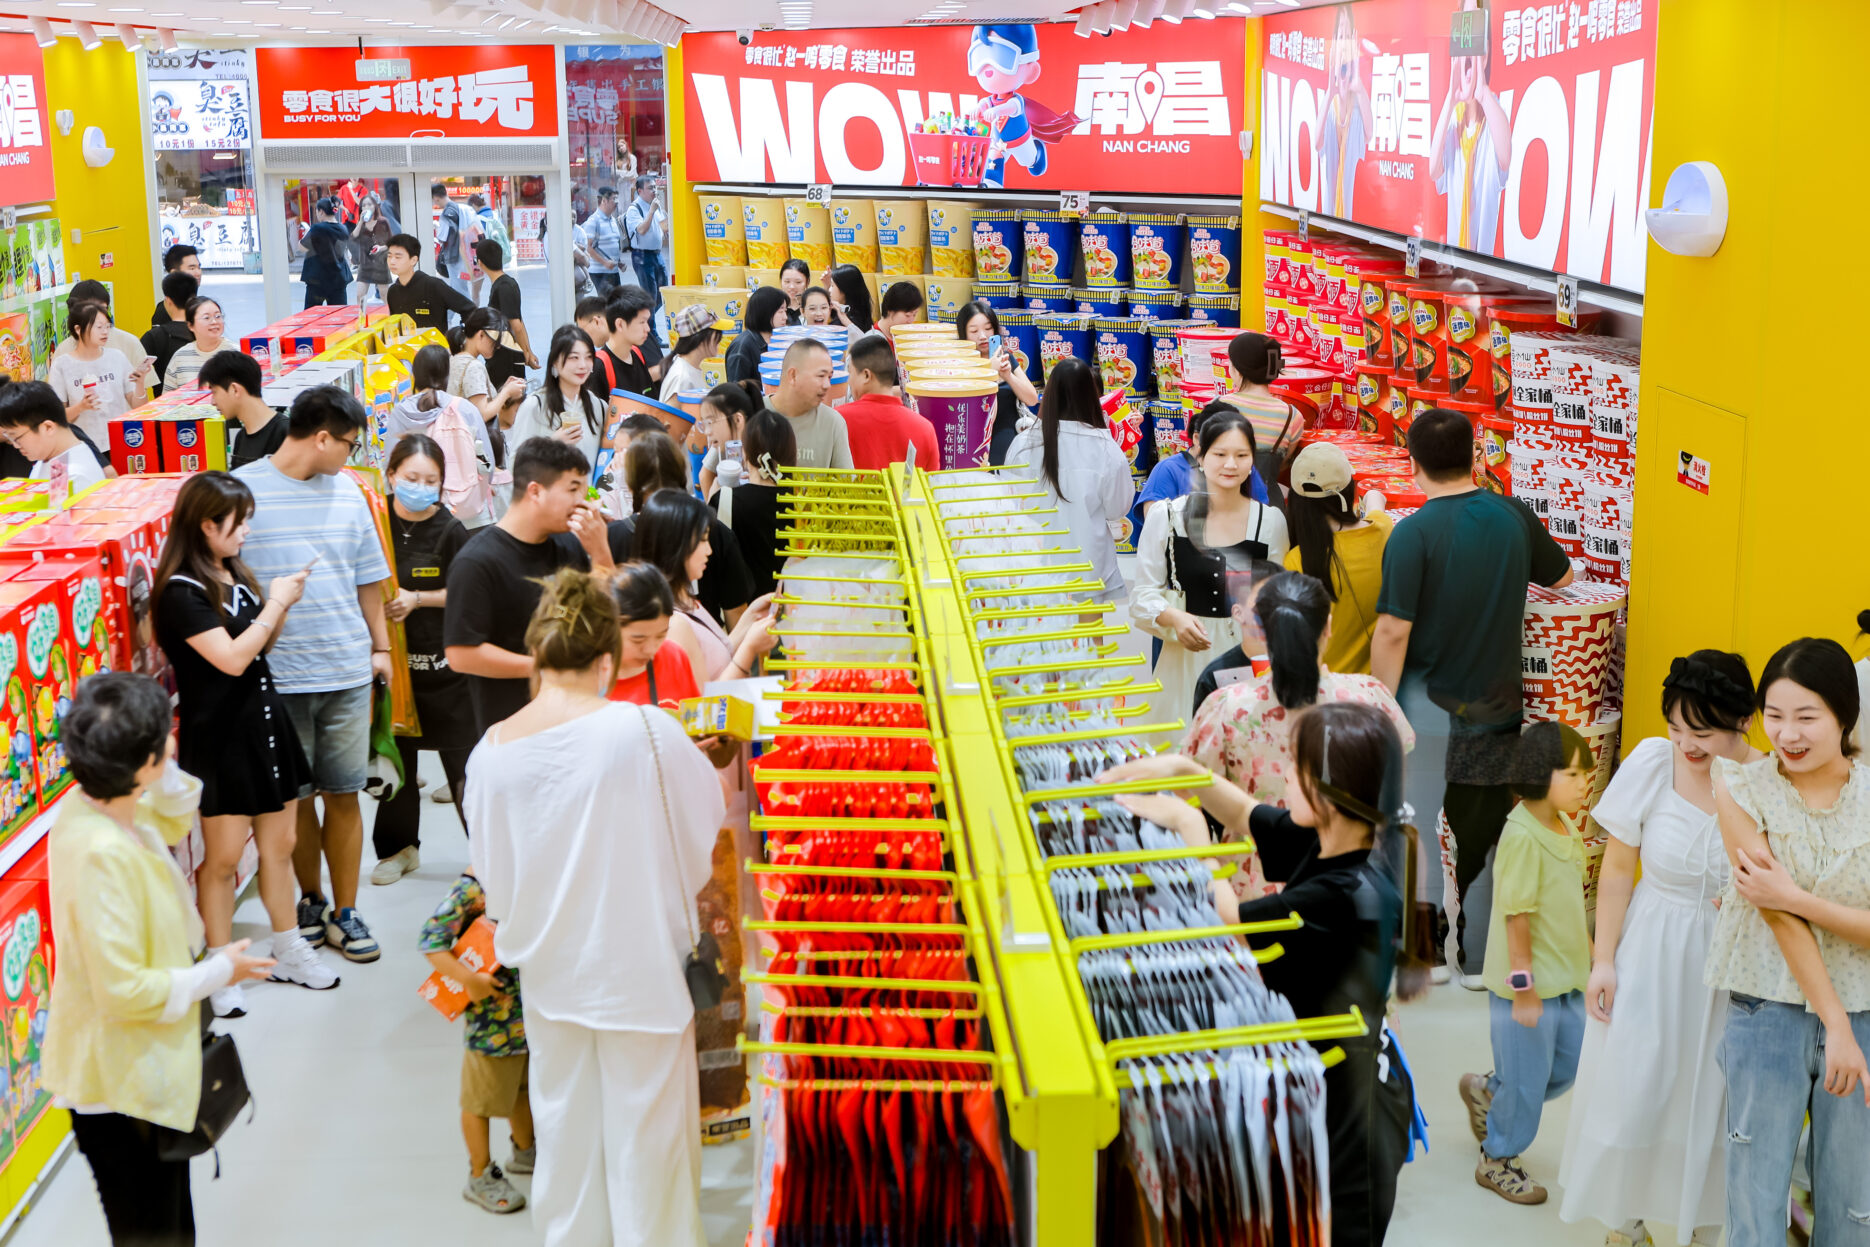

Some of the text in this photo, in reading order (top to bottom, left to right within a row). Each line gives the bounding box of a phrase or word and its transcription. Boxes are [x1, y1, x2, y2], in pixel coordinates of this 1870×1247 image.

[850, 49, 916, 77] 荣誉出品
[1071, 60, 1232, 136] 南昌
[0, 74, 43, 148] 昌
[283, 114, 361, 123] BUSY FOR YOU
[1102, 140, 1191, 154] NAN CHANG
[9, 152, 31, 166] CHANG
[1493, 58, 1653, 292] OW
[807, 187, 823, 200] 68
[1062, 194, 1079, 209] 75
[1558, 282, 1571, 309] 69
